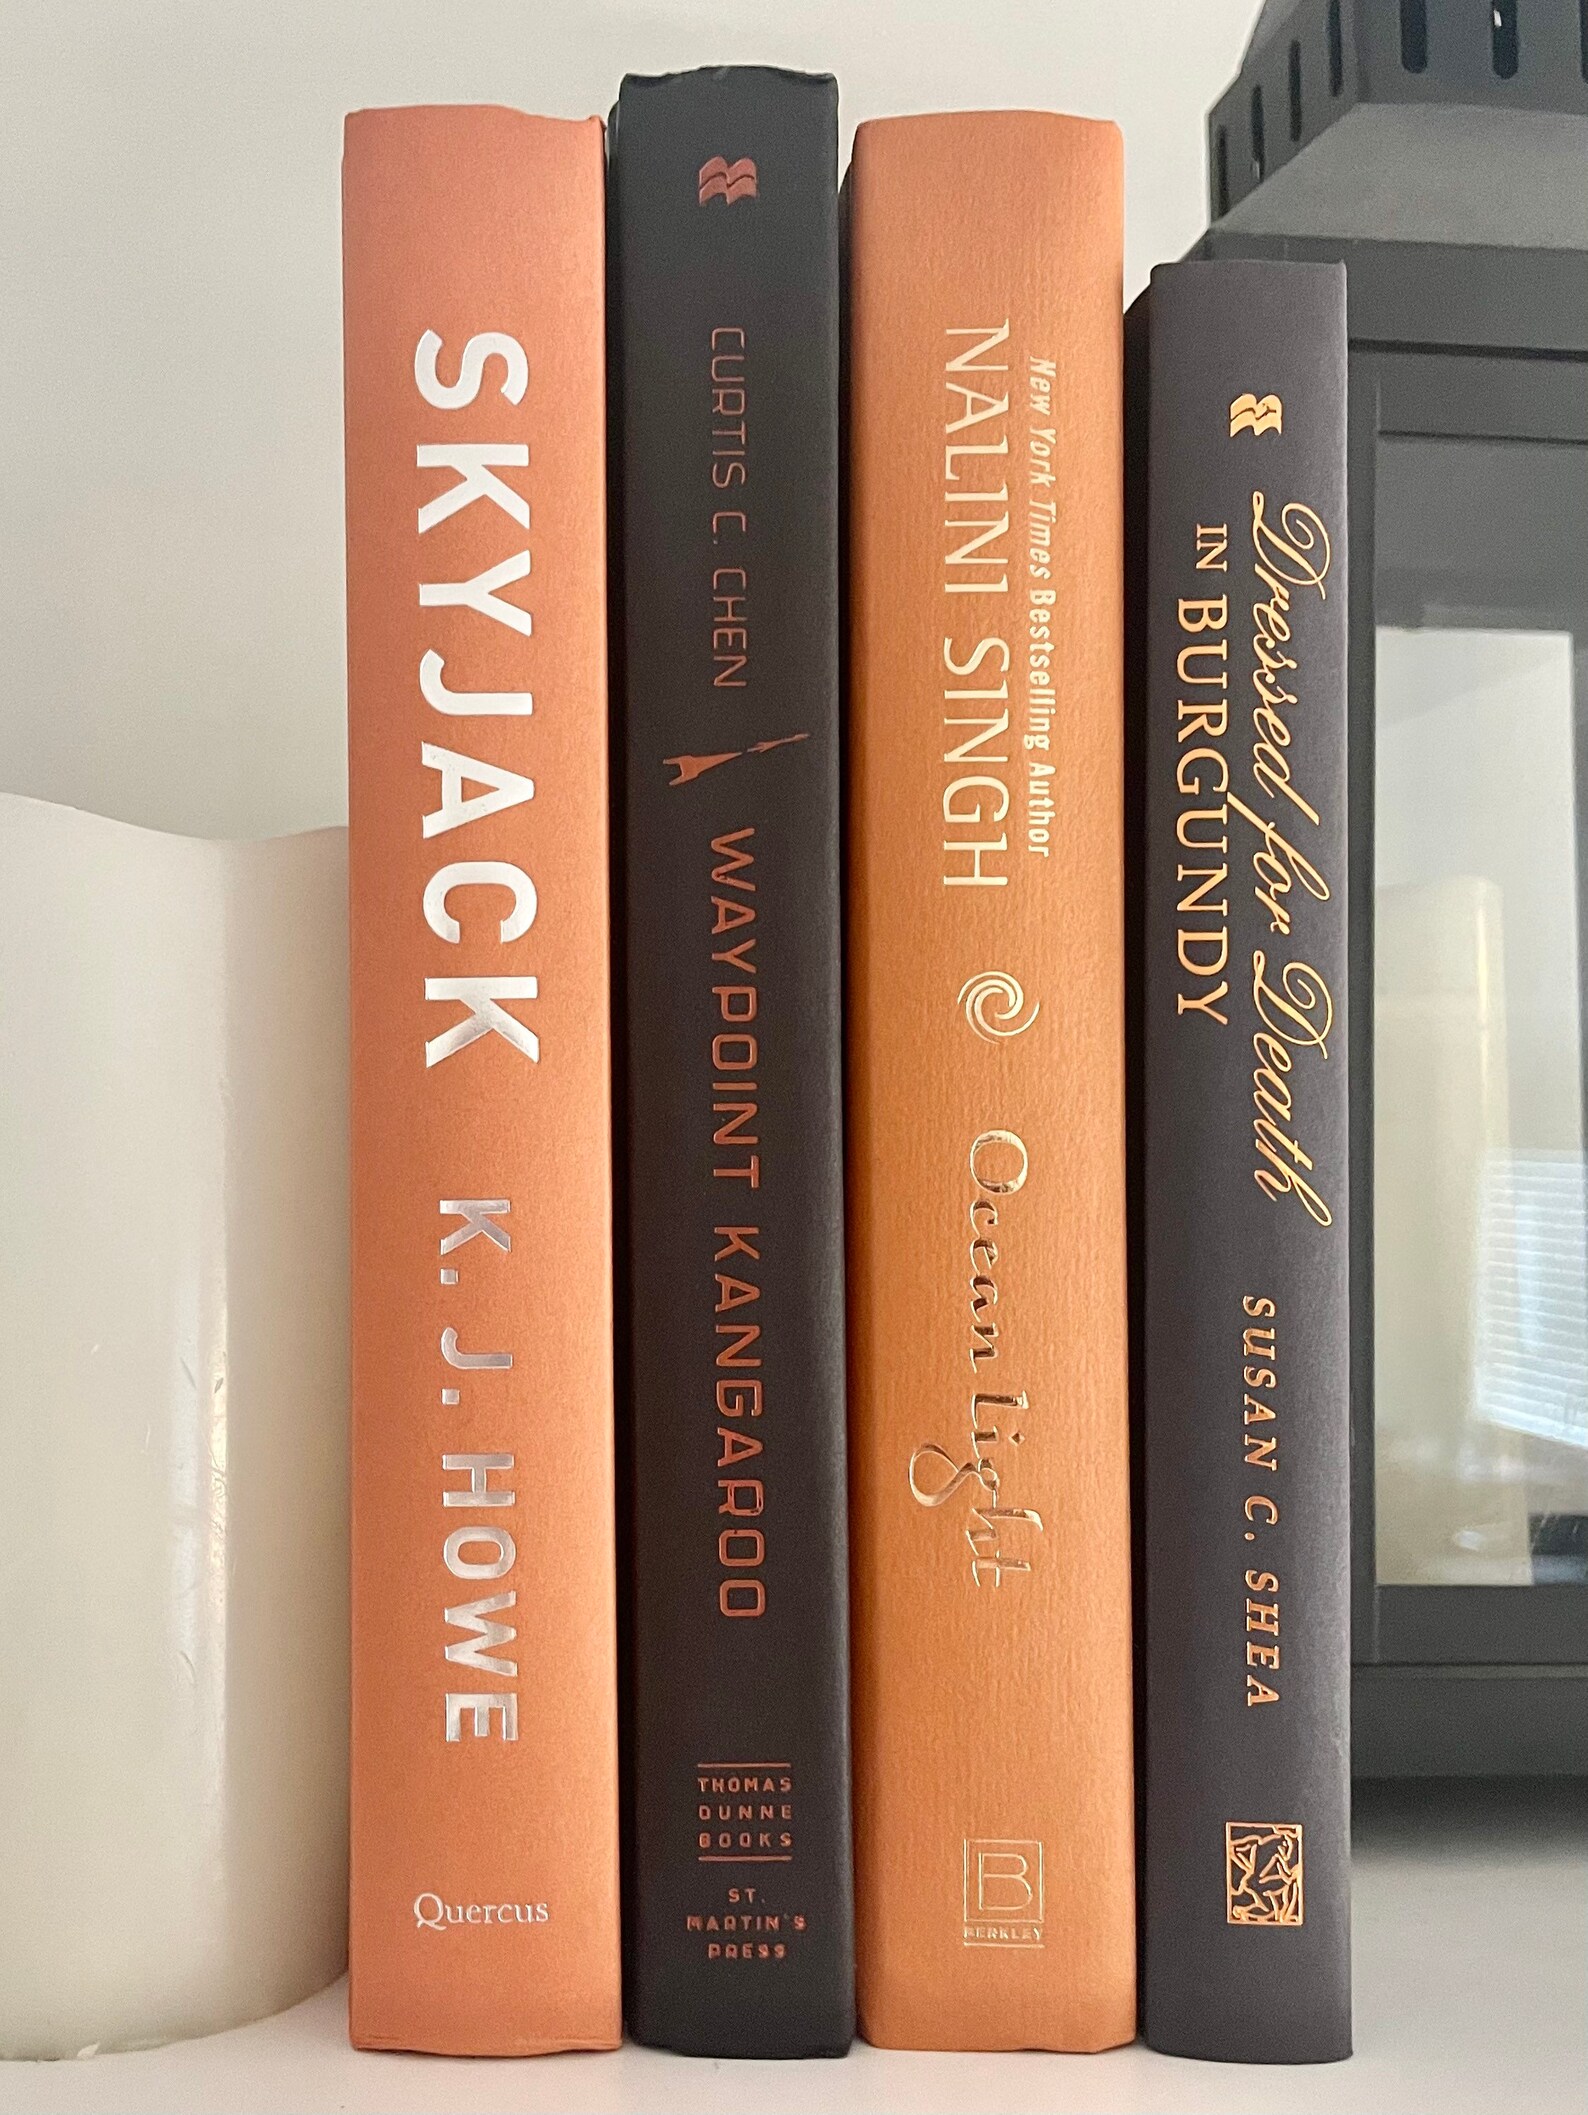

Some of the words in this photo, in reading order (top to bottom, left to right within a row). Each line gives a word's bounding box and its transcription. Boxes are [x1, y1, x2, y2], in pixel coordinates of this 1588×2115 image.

[711, 326, 747, 489] CURTIS
[1029, 356, 1055, 416] New
[943, 318, 1010, 595] NALINI
[1029, 427, 1056, 489] York
[711, 512, 747, 546] C.
[1029, 499, 1056, 580] Times
[1195, 523, 1229, 573] IN
[712, 568, 748, 688] CHEN
[1023, 589, 1056, 751] Bestselling
[1252, 490, 1330, 826] Dressed
[414, 329, 539, 1068] SKYJACK
[942, 637, 1009, 887] SINGH
[1028, 762, 1056, 858] Author
[1175, 597, 1230, 1026] BURGUNDY
[1226, 791, 1331, 936] for
[710, 827, 762, 1188] WAYPOINT
[1252, 950, 1333, 1228] Death
[968, 1129, 1028, 1373] Ocean
[713, 1226, 766, 1618] KANGAROO
[1242, 1295, 1279, 1471] SUSAN
[908, 1390, 1043, 1588] Light
[1243, 1496, 1279, 1541] C.
[442, 1452, 518, 1742] HOWE
[1244, 1569, 1280, 1707] SHEA
[697, 1777, 792, 1793] THOMAS
[698, 1804, 793, 1821] DUNNE
[698, 1832, 793, 1849] BOOKS
[413, 1893, 549, 1930] Quercus
[686, 1914, 807, 1932] MARTIN'S
[707, 1943, 787, 1960] PRESS
[728, 1888, 766, 1904] ST.
[963, 1926, 1042, 1942] BERKLEY
